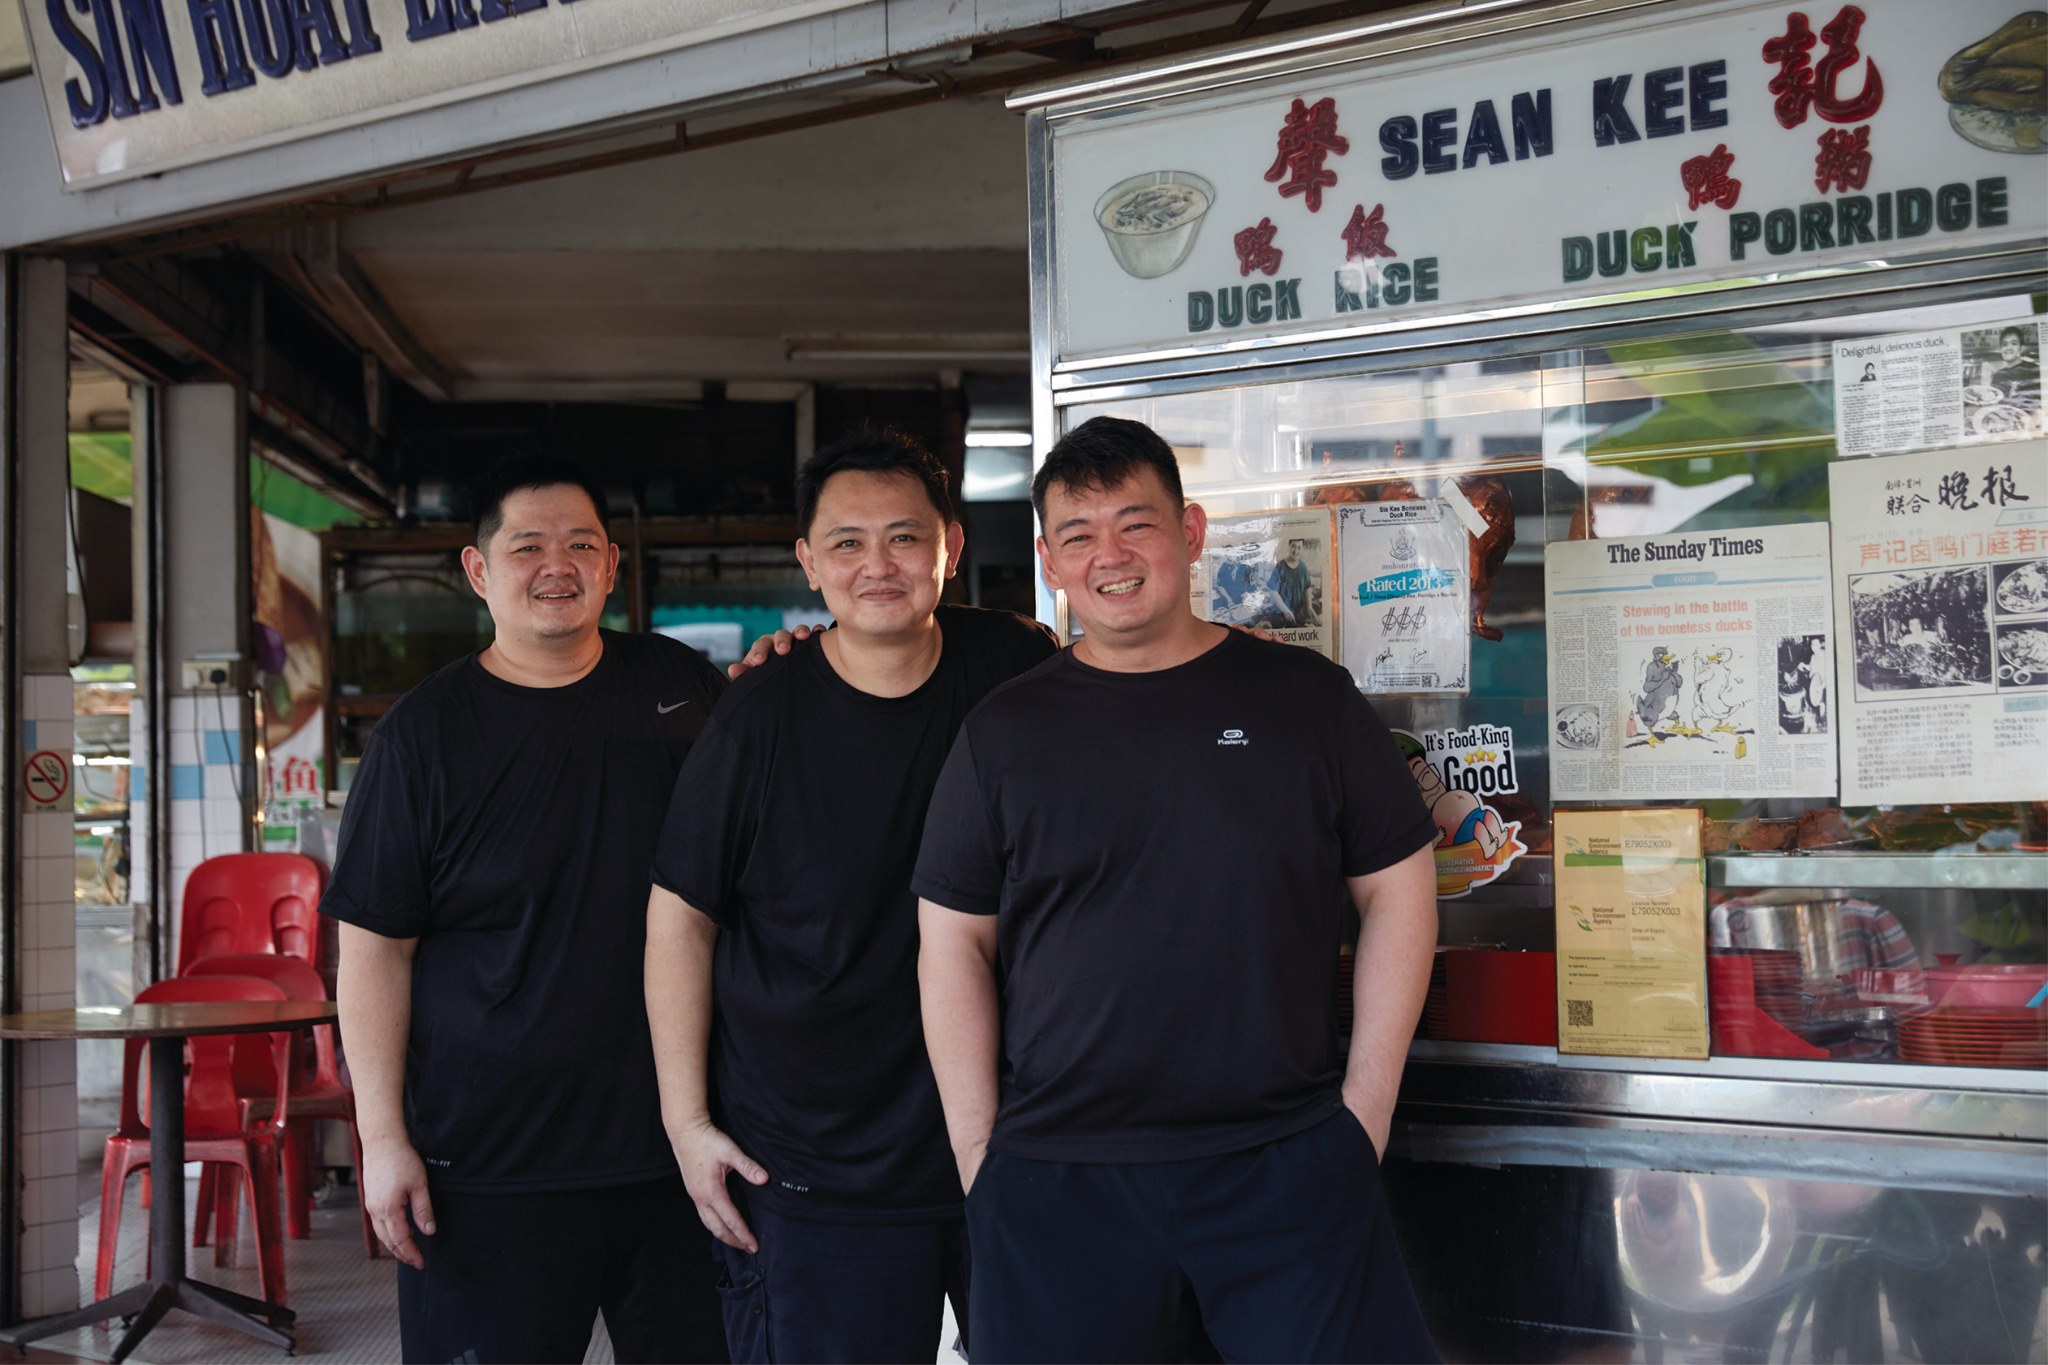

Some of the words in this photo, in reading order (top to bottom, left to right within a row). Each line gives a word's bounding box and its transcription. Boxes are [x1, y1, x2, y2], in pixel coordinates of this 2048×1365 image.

[46, 0, 184, 129] SIN
[1762, 5, 1884, 129] 記
[1379, 88, 1554, 181] SEAN
[1593, 59, 1728, 147] KEE
[1562, 220, 1698, 283] DUCK
[1729, 176, 2008, 261] PORRIDGE
[1187, 278, 1303, 332] DUCK
[1334, 257, 1439, 313] RICE
[1885, 340, 1922, 353] delicious
[1607, 543, 1641, 564] The
[1644, 539, 1707, 562] Sunday
[1709, 536, 1764, 557] Times
[1366, 577, 1407, 592] Rated
[1408, 577, 1441, 591] 2013
[1622, 602, 1671, 619] Stewing
[1674, 602, 1686, 615] in
[1690, 601, 1710, 614] the
[1713, 599, 1748, 613] battle
[1298, 629, 1319, 641] work
[1620, 624, 1632, 637] of
[1635, 623, 1655, 636] the
[1658, 621, 1712, 635] boneless
[1715, 618, 1753, 633] ducks
[1425, 734, 1444, 752] It's
[1447, 727, 1510, 749] Food-King
[1443, 750, 1516, 793] Good
[1631, 906, 1681, 916] E79052X003
